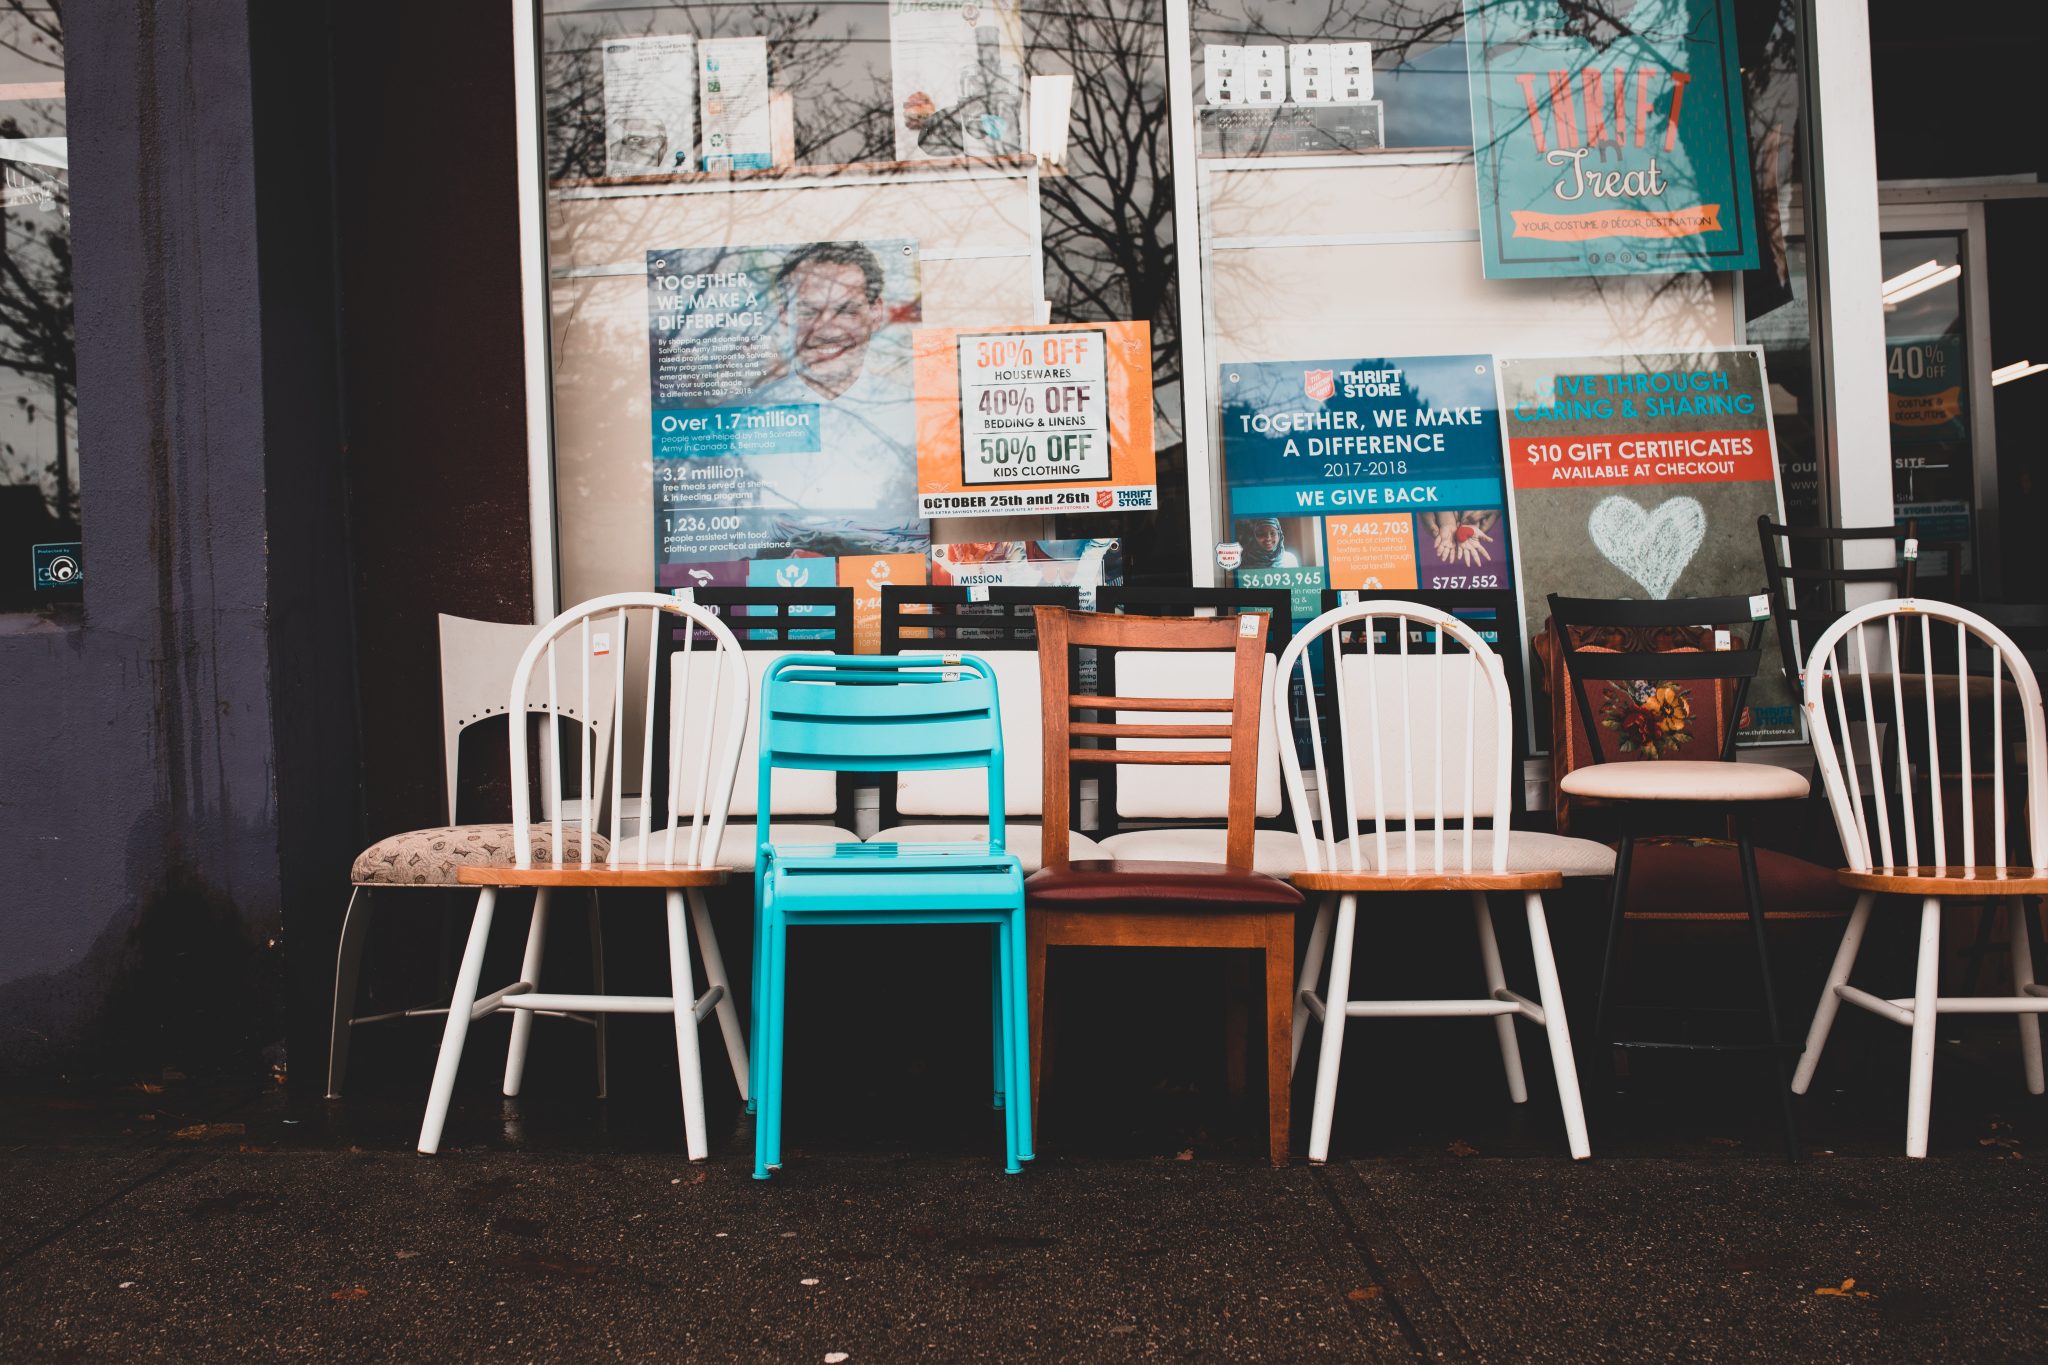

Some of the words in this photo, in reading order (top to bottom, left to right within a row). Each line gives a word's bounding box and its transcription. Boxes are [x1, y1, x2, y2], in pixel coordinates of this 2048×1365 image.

[1515, 67, 1690, 152] THRIFT
[1546, 148, 1668, 200] Treat
[1522, 222, 1552, 232] YOUR
[1554, 220, 1598, 230] COSTUME
[1612, 216, 1646, 229] DÉCOR
[1646, 216, 1712, 228] DESTINATION
[656, 272, 752, 290] TOGETHER,
[657, 296, 683, 310] WE
[688, 292, 740, 309] MAKE
[745, 292, 758, 306] A
[658, 312, 762, 330] DIFFERENCE
[720, 336, 750, 344] donating
[682, 355, 708, 363] provide
[710, 353, 737, 362] support
[977, 339, 1033, 368] 30%
[1043, 338, 1088, 366] OFF
[995, 369, 1071, 380] HOUSEWARES
[1340, 369, 1402, 384] THRIFT
[1927, 366, 1946, 379] OFF
[693, 381, 720, 389] support
[1344, 383, 1401, 398] STORE
[1536, 375, 1597, 397] GIVE
[1604, 371, 1729, 395] THROUGH
[979, 388, 1034, 416] 40%
[1045, 385, 1091, 414] OFF
[1514, 400, 1614, 422] CARING
[1622, 400, 1638, 418] &
[1645, 394, 1755, 417] SHARING
[1897, 399, 1935, 408] COSTUME
[662, 416, 708, 432] Over
[714, 413, 741, 430] 1.7
[748, 411, 810, 428] million
[984, 418, 1034, 429] BEDDING
[1038, 418, 1045, 427] &
[1049, 416, 1086, 427] LINENS
[1240, 410, 1366, 433] TOGETHER,
[1373, 409, 1407, 428] WE
[1416, 406, 1482, 427] MAKE
[661, 436, 689, 444] people
[712, 433, 740, 441] helped
[742, 431, 752, 440] by
[769, 430, 806, 438] Salvation
[661, 445, 682, 453] Army
[685, 443, 691, 451] in
[694, 442, 728, 451] Canada
[738, 440, 775, 449] Bermuda
[980, 436, 1036, 464] 50%
[1047, 434, 1092, 462] OFF
[1283, 438, 1300, 457] A
[1309, 434, 1445, 456] DIFFERENCE
[1527, 444, 1561, 464] $10
[1568, 442, 1611, 461] GIFT
[1618, 437, 1753, 459] CERTIFICATES
[663, 467, 686, 481] 3.2
[691, 466, 744, 479] million
[994, 466, 1018, 477] KIDS
[1022, 464, 1080, 477] CLOTHING
[1324, 461, 1407, 477] 2017-2018
[1551, 465, 1629, 480] AVAILABLE
[1633, 464, 1650, 476] AT
[1655, 461, 1735, 476] CHECKOUT
[663, 484, 679, 492] free
[681, 483, 706, 491] meals
[708, 481, 735, 490] served
[1117, 490, 1152, 498] THRIFT
[680, 492, 712, 502] feeding
[714, 492, 753, 501] programs
[924, 496, 986, 509] OCTOBER
[990, 495, 1022, 506] 25th
[1026, 494, 1052, 505] and
[1057, 492, 1090, 504] 26th
[1119, 498, 1151, 506] STORE
[1296, 490, 1325, 507] WE
[1331, 488, 1377, 505] GIVE
[1384, 486, 1438, 503] BACK
[665, 516, 740, 533] 1,236,000
[1331, 522, 1409, 537] 79,442,703
[664, 535, 693, 543] people
[696, 533, 728, 542] assisted
[664, 544, 697, 553] clothing
[709, 542, 746, 552] practical
[748, 541, 791, 549] assistance
[960, 575, 1002, 585] MISSION
[1243, 572, 1321, 588] $6,093,965
[1432, 575, 1497, 589] $757,552
[1754, 705, 1792, 715] THRIFT
[1756, 717, 1792, 726] STORE
